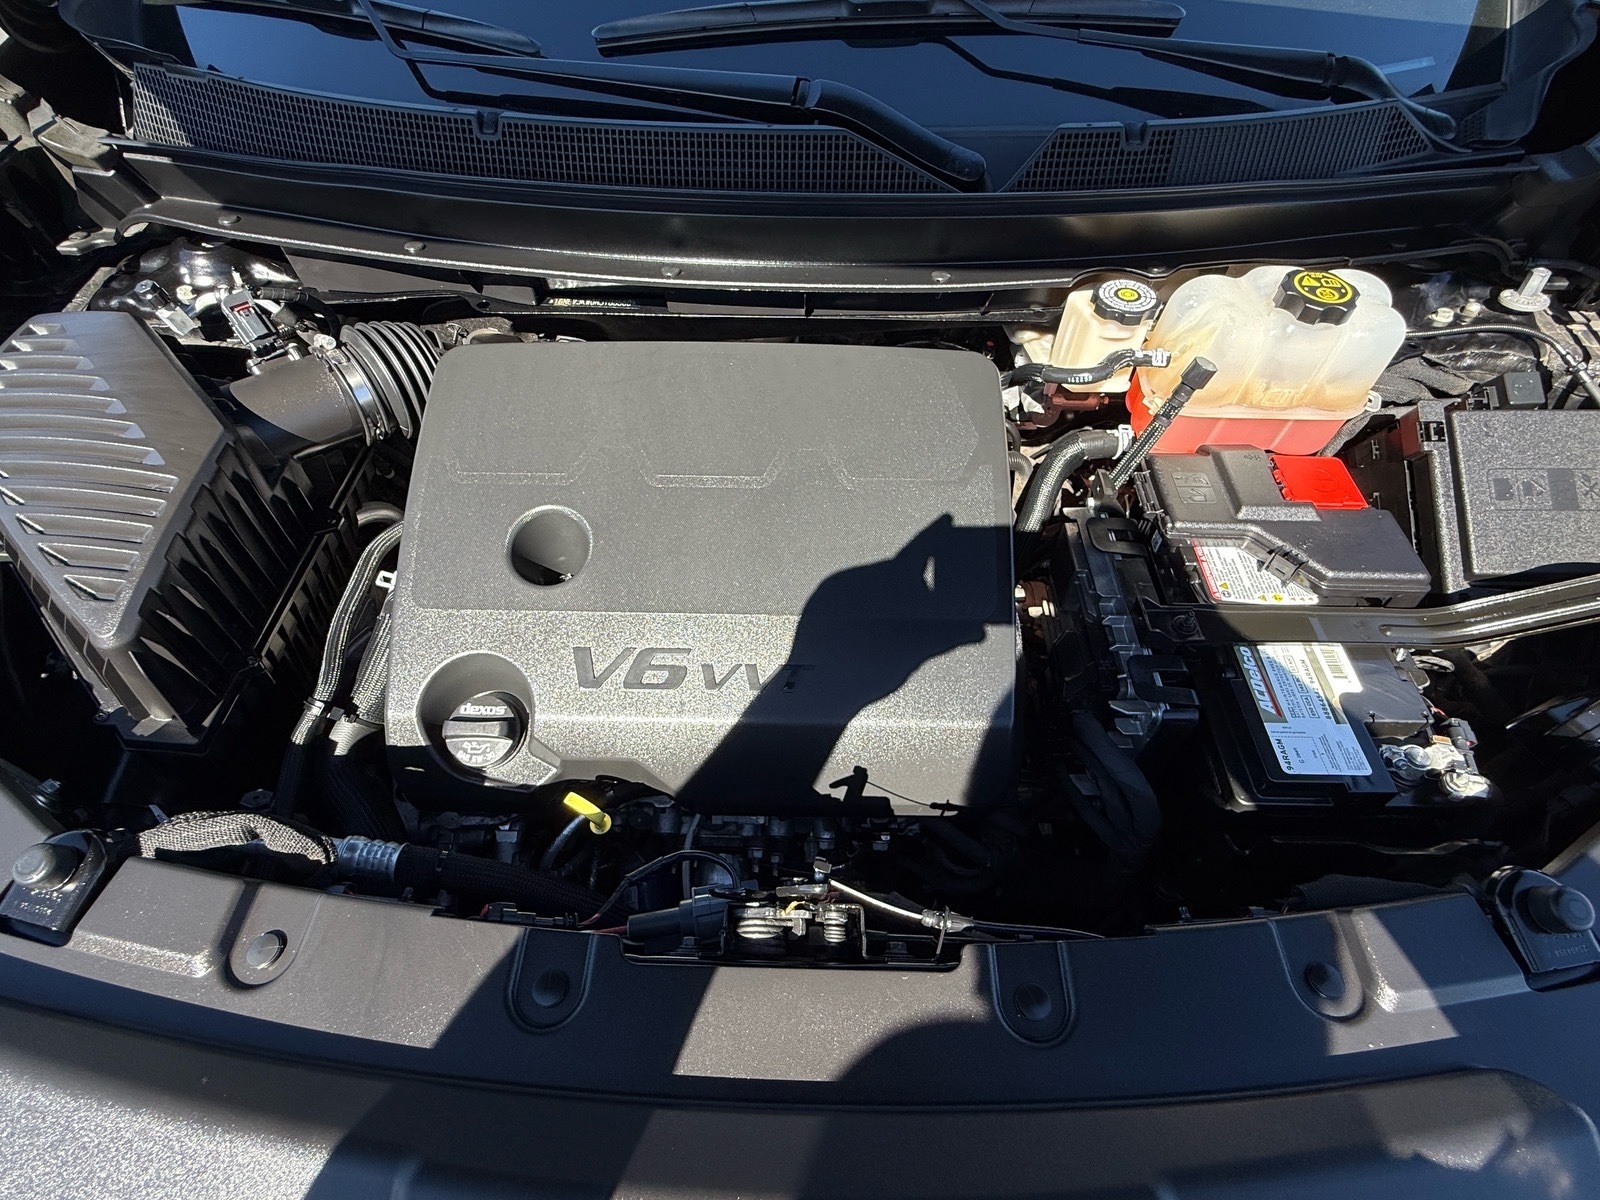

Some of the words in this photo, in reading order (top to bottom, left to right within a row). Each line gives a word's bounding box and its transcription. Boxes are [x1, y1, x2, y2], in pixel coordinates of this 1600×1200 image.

[572, 647, 692, 690] V6
[1240, 646, 1277, 714] ACDelco
[460, 703, 508, 715] dexos
[1275, 738, 1294, 771] 94RAGM
